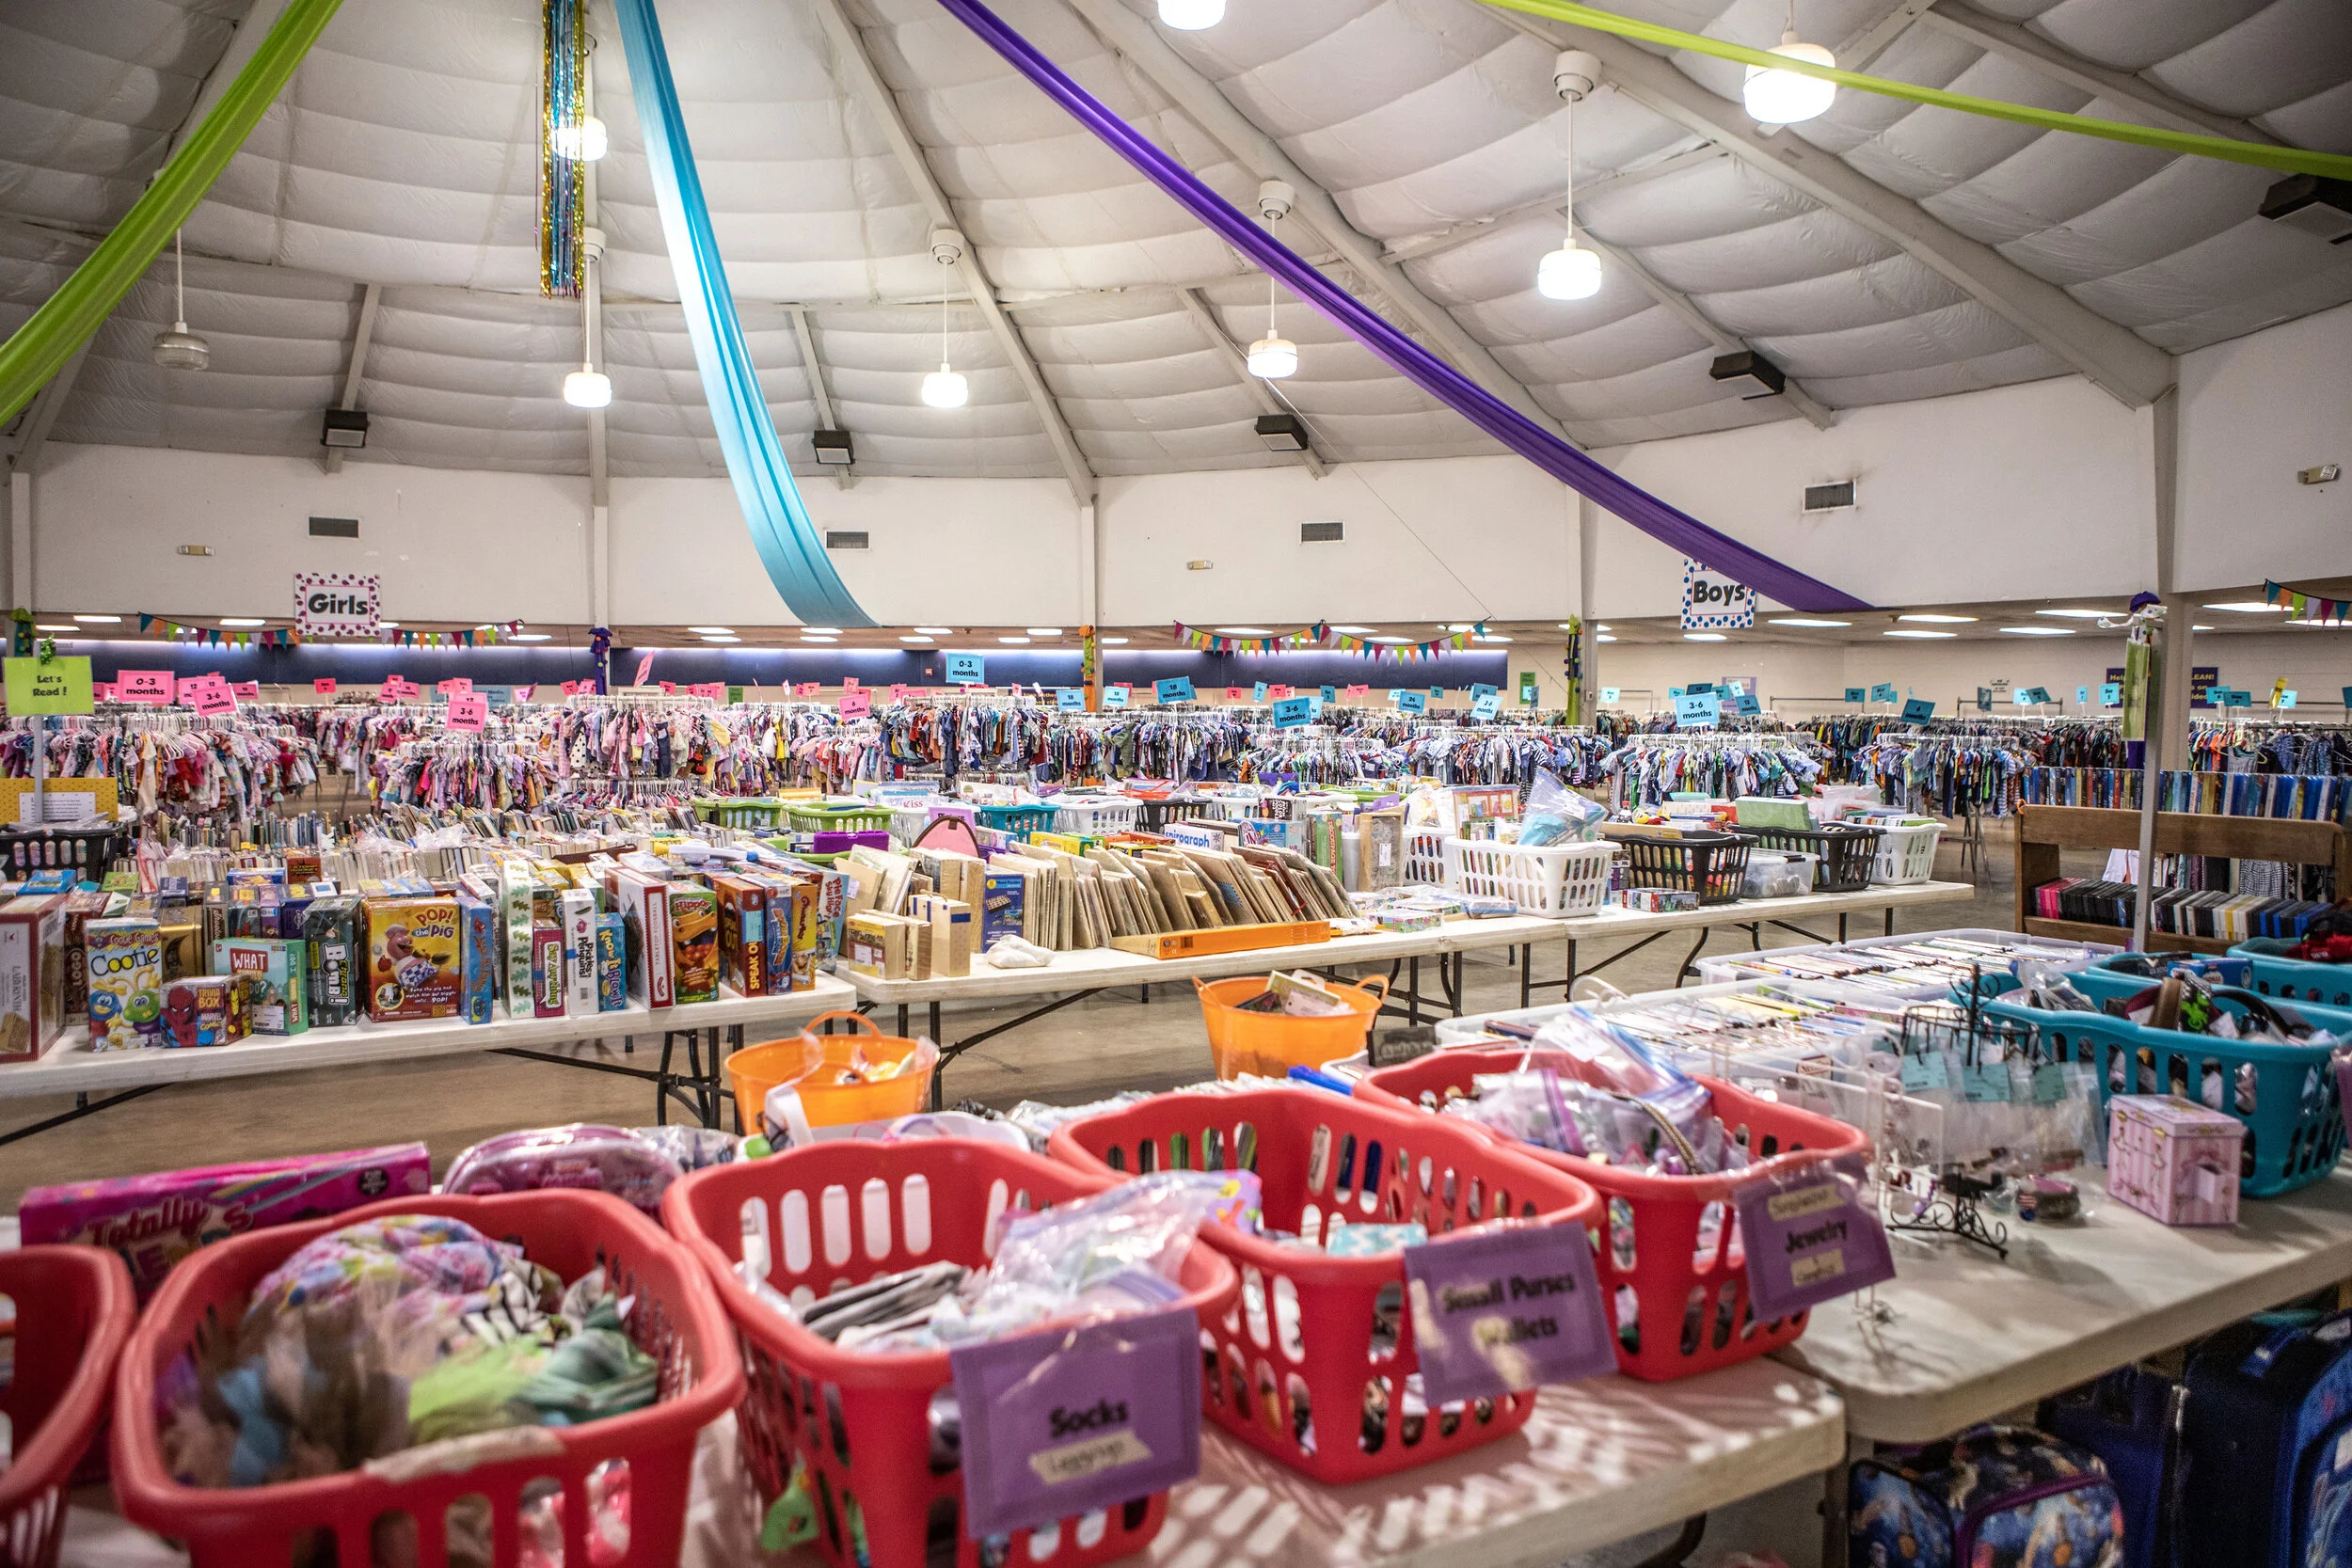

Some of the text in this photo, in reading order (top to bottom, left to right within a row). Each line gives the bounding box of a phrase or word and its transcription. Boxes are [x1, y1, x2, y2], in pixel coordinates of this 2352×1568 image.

[1692, 579, 1745, 607] Boys
[307, 594, 369, 616] Girls
[952, 669, 979, 677] months
[37, 674, 62, 685] Let's
[135, 677, 156, 686] 0-3
[32, 687, 60, 697] Read
[125, 688, 166, 696] months
[206, 692, 221, 701] 3-6
[1162, 690, 1186, 699] months
[201, 700, 231, 711] months
[844, 706, 866, 715] months
[1689, 701, 1704, 709] 3-6
[460, 707, 473, 716] 3-6
[1682, 710, 1712, 720] months
[1279, 713, 1307, 723] months
[833, 877, 844, 918] Pie Face
[414, 927, 430, 937] the
[598, 928, 621, 970] Know It
[90, 946, 160, 976] Cootie
[232, 952, 266, 970] WHAT
[71, 952, 83, 987] LOGO
[547, 943, 561, 1006] Say Anything
[749, 955, 760, 990] SPEAK
[198, 988, 221, 999] TRIVIA
[198, 997, 220, 1009] BOX
[87, 1196, 211, 1245] Totally
[1785, 1219, 1848, 1254] Jewelry
[1508, 1272, 1576, 1301] Purses
[1049, 1398, 1129, 1439] Socks
